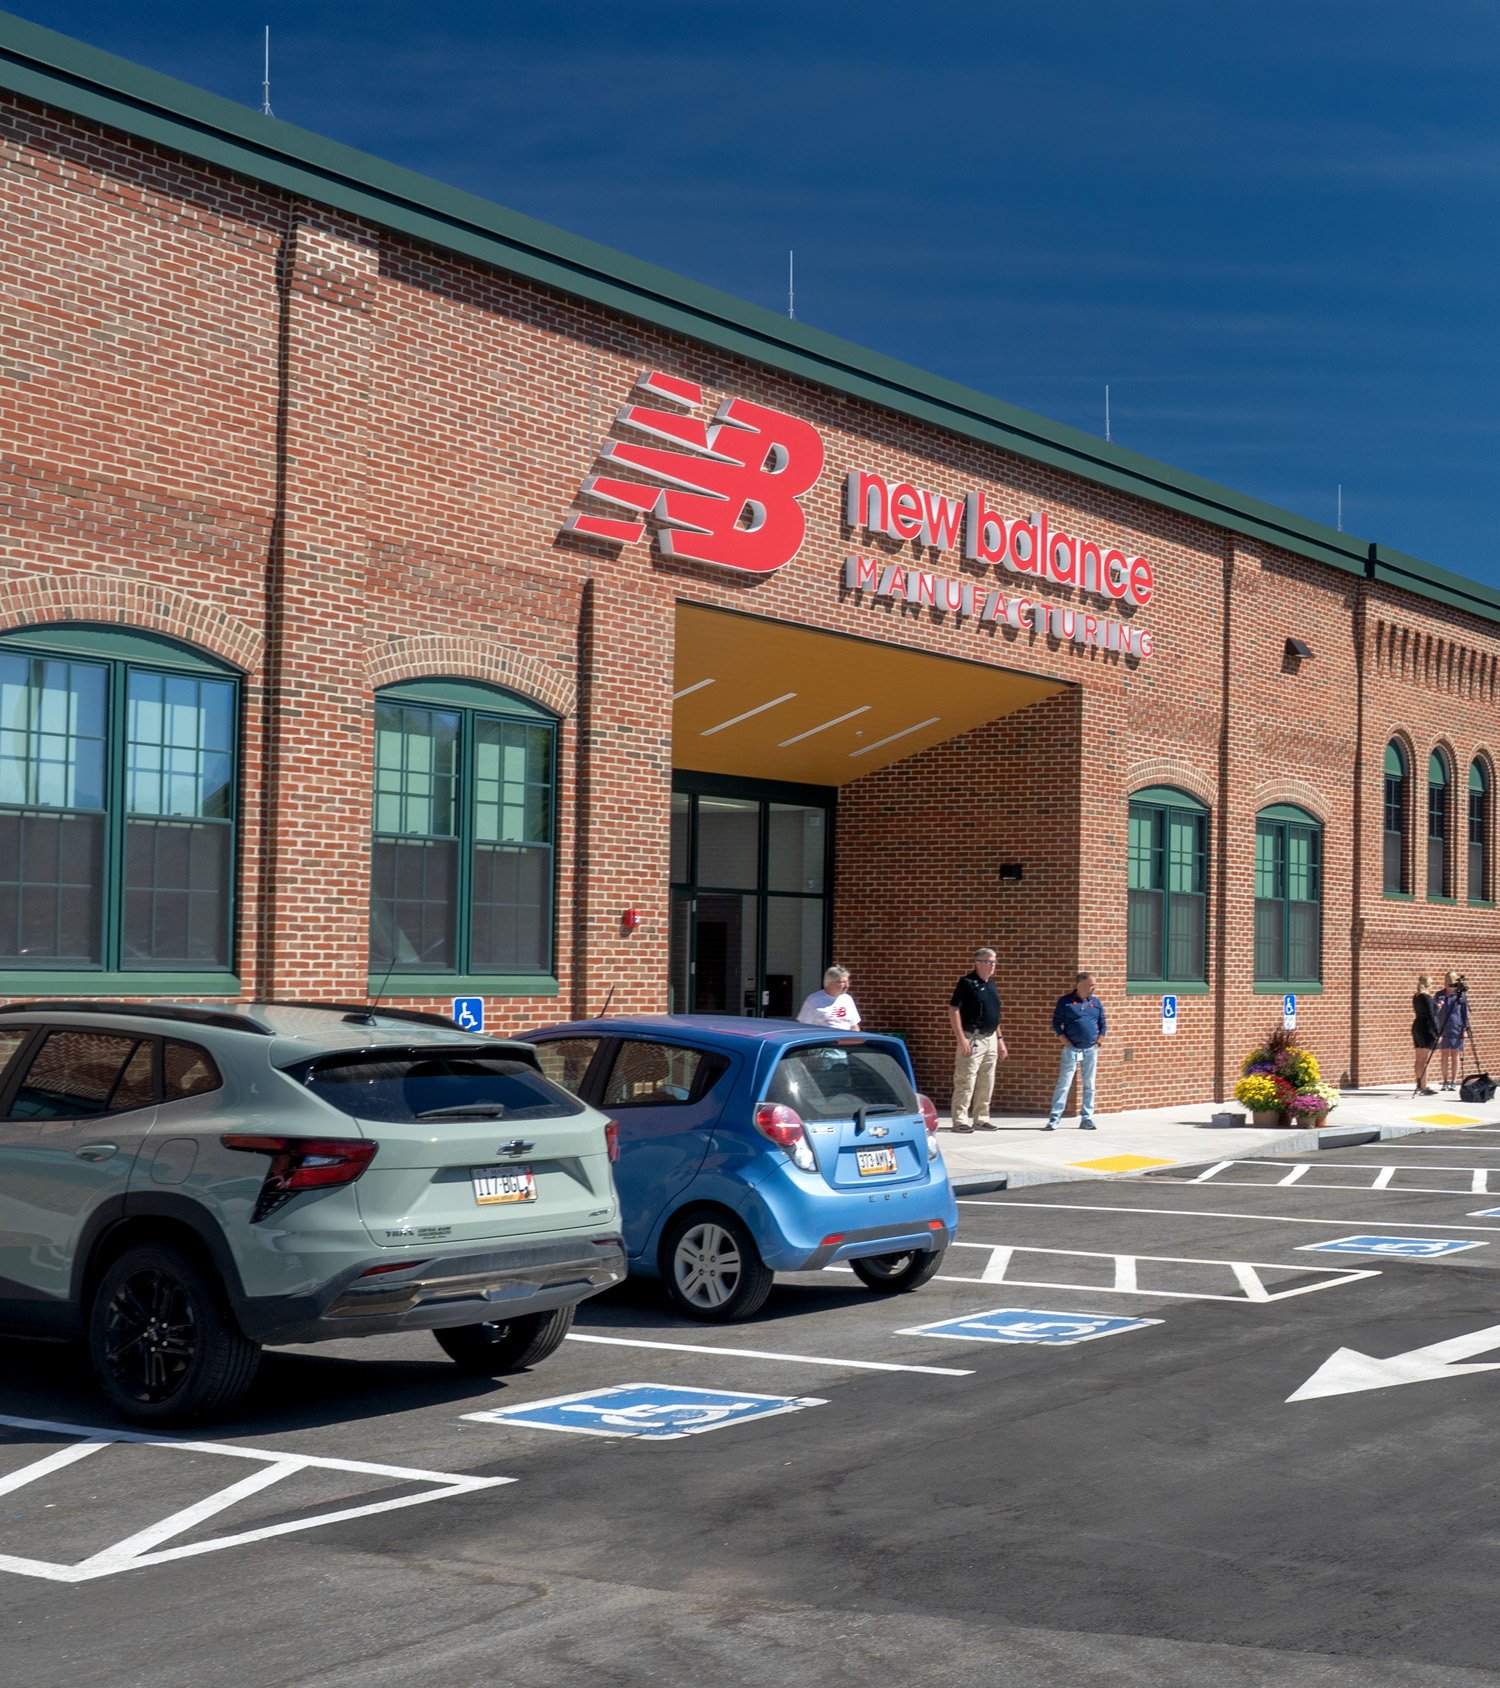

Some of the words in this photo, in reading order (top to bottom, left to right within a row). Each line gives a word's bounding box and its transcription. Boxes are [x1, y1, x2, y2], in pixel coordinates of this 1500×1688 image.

[853, 471, 964, 550] new
[971, 491, 1154, 605] balance
[852, 555, 1154, 657] MANUFACTURING
